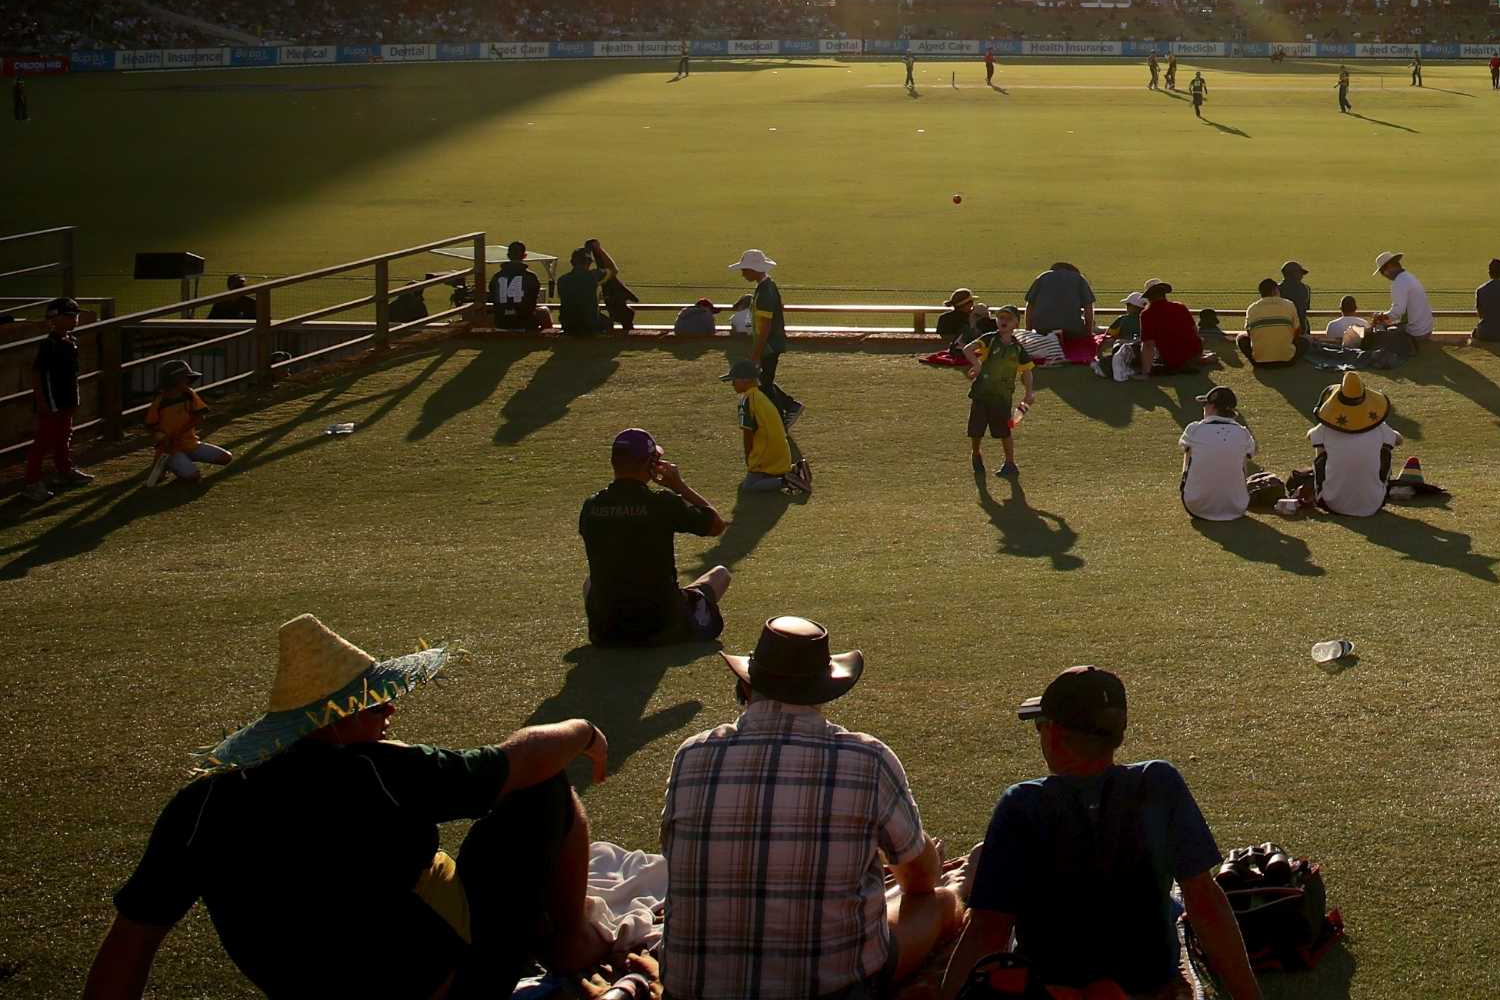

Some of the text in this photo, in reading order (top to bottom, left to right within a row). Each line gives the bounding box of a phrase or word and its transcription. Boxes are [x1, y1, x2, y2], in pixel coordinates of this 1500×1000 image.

[601, 43, 633, 53] Health
[735, 42, 773, 52] Medical
[826, 41, 858, 50] Dental
[918, 41, 971, 53] Aged Care
[1031, 42, 1113, 52] Health Insurance
[1361, 45, 1388, 56] Aged
[1463, 45, 1496, 55] Health
[390, 46, 425, 57] Dental
[122, 53, 160, 66] Health
[498, 275, 524, 304] 14
